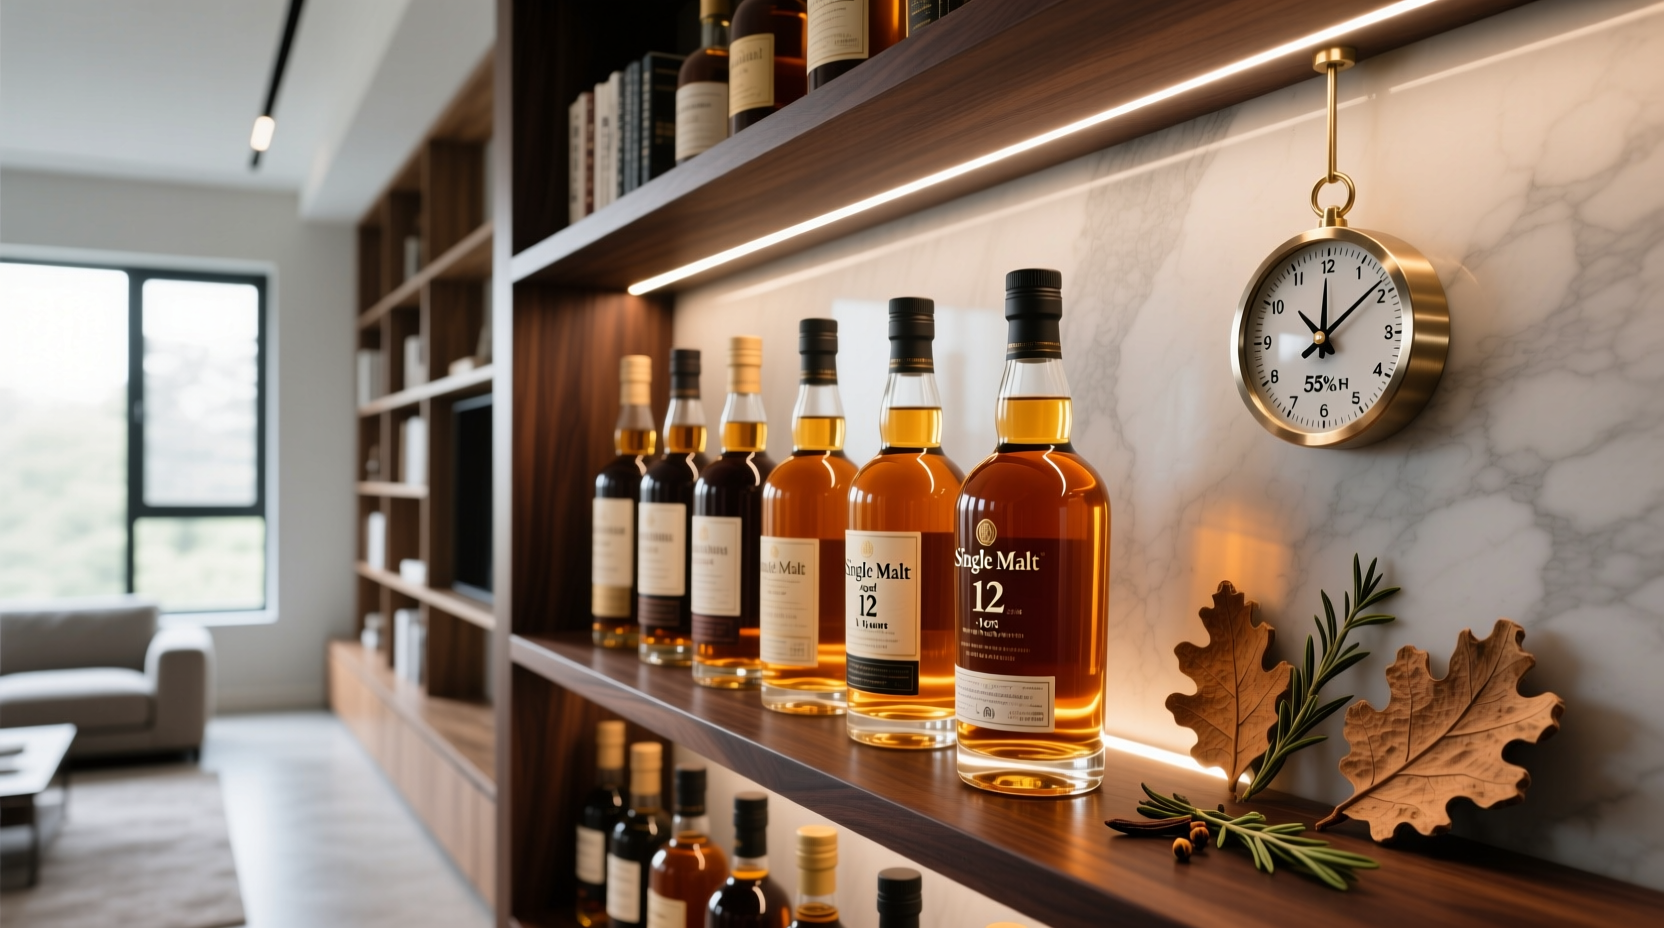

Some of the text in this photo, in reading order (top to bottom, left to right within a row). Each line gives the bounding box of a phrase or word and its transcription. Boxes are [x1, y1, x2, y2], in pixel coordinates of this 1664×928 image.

[1320, 259, 1335, 274] 12
[1356, 265, 1361, 279] 1
[1293, 271, 1304, 286] 11
[1376, 289, 1386, 304] 2
[1271, 299, 1285, 315] 10
[1384, 324, 1394, 340] 3
[1263, 335, 1272, 350] 9
[1270, 369, 1279, 384] 8
[1372, 362, 1383, 377] 4
[1289, 395, 1299, 410] 7
[1351, 391, 1361, 405] 5
[1319, 404, 1329, 418] 6
[996, 550, 1040, 571] Malt
[876, 562, 912, 580] Malt
[972, 580, 1005, 614] 12
[859, 594, 877, 618] 12
